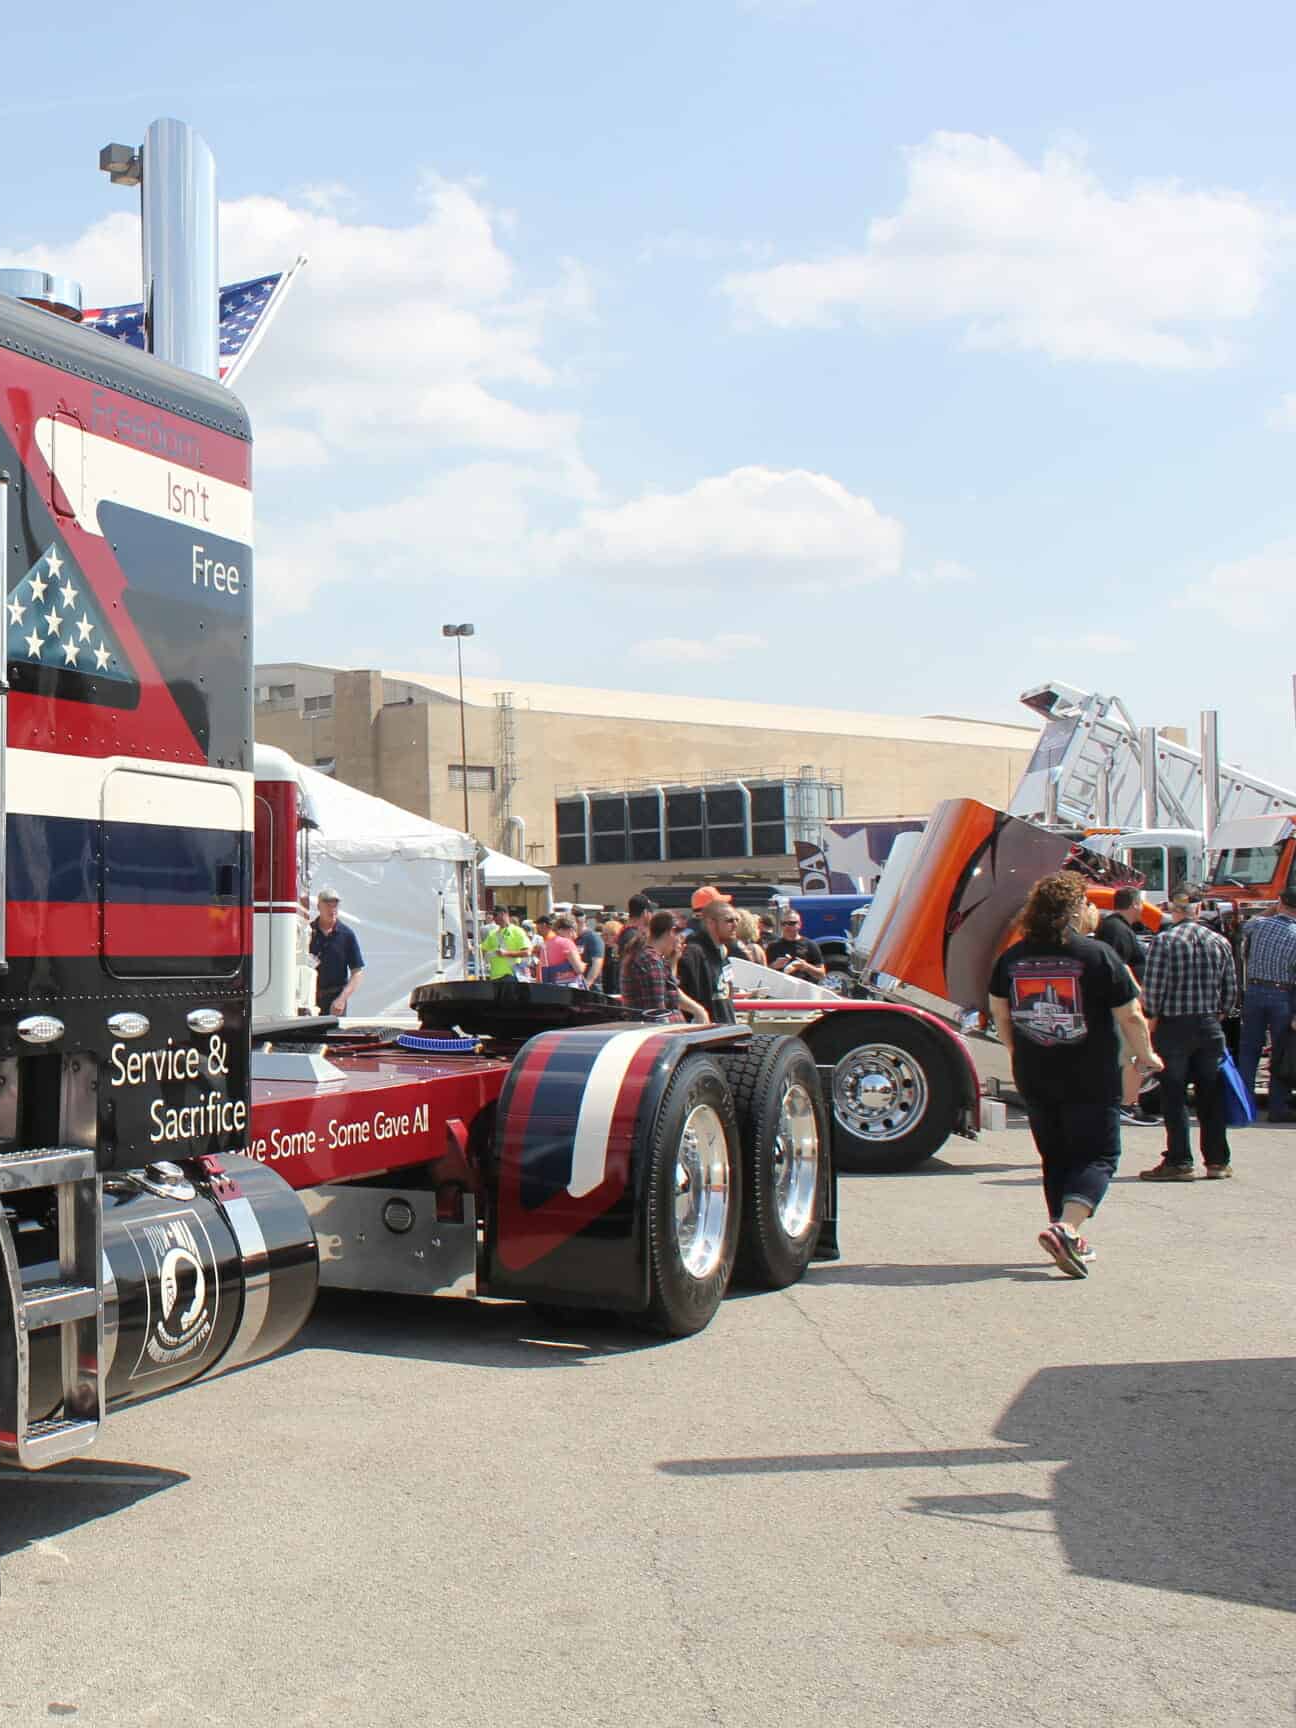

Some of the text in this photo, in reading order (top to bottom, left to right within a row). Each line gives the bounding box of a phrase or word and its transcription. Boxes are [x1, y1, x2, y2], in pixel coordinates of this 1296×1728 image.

[91, 389, 201, 467] Freedom
[167, 471, 209, 522] Isn't
[191, 544, 241, 596] Free
[111, 1034, 229, 1087] Service &
[150, 1091, 246, 1142] Sacrifice
[270, 1128, 316, 1160] Some
[328, 1119, 370, 1149] Some
[374, 1111, 409, 1140] Gave
[413, 1103, 430, 1134] All
